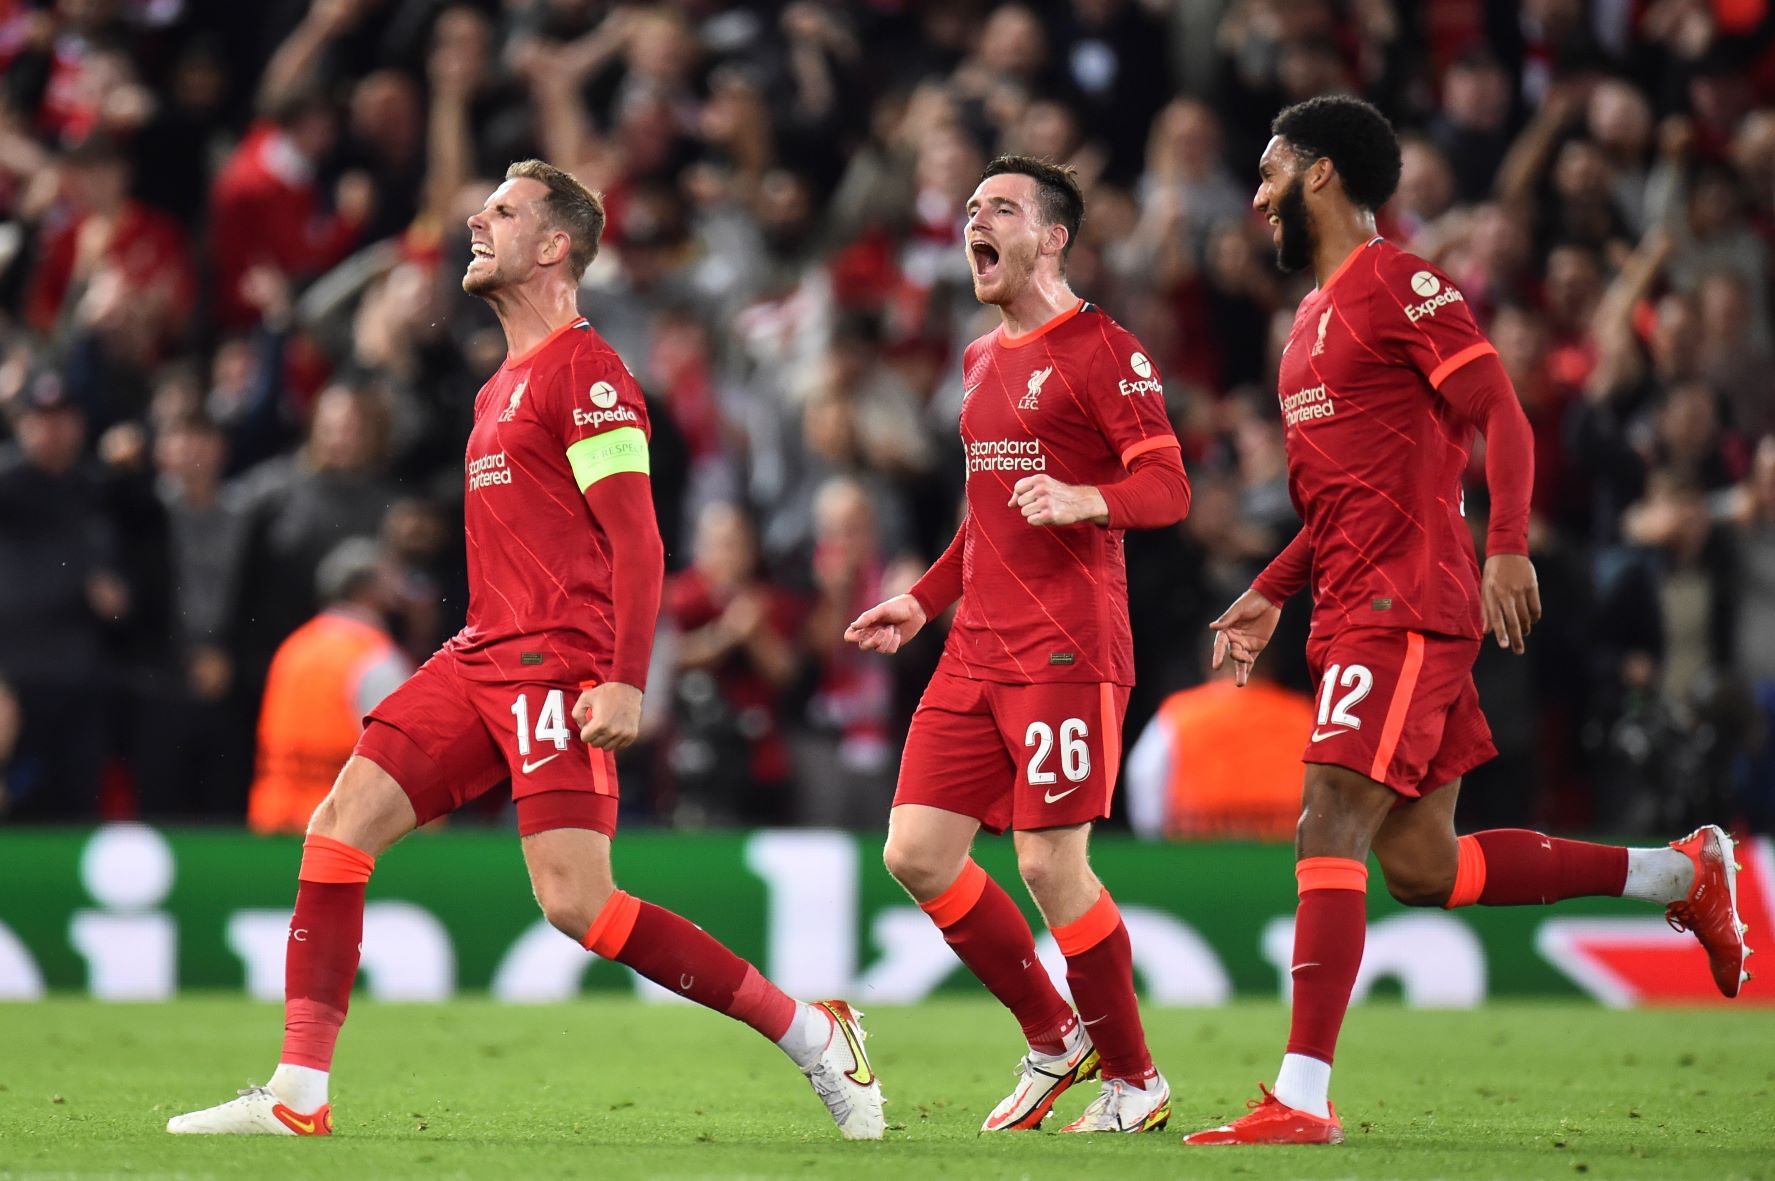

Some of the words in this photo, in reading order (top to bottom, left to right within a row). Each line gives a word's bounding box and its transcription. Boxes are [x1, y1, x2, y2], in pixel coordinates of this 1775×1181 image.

[1118, 377, 1163, 396] Exped
[572, 404, 637, 429] Expedia
[970, 438, 1039, 455] standard
[970, 455, 1046, 472] chartered
[1317, 664, 1374, 730] 12
[510, 689, 571, 756] 14
[1024, 717, 1091, 785] 26
